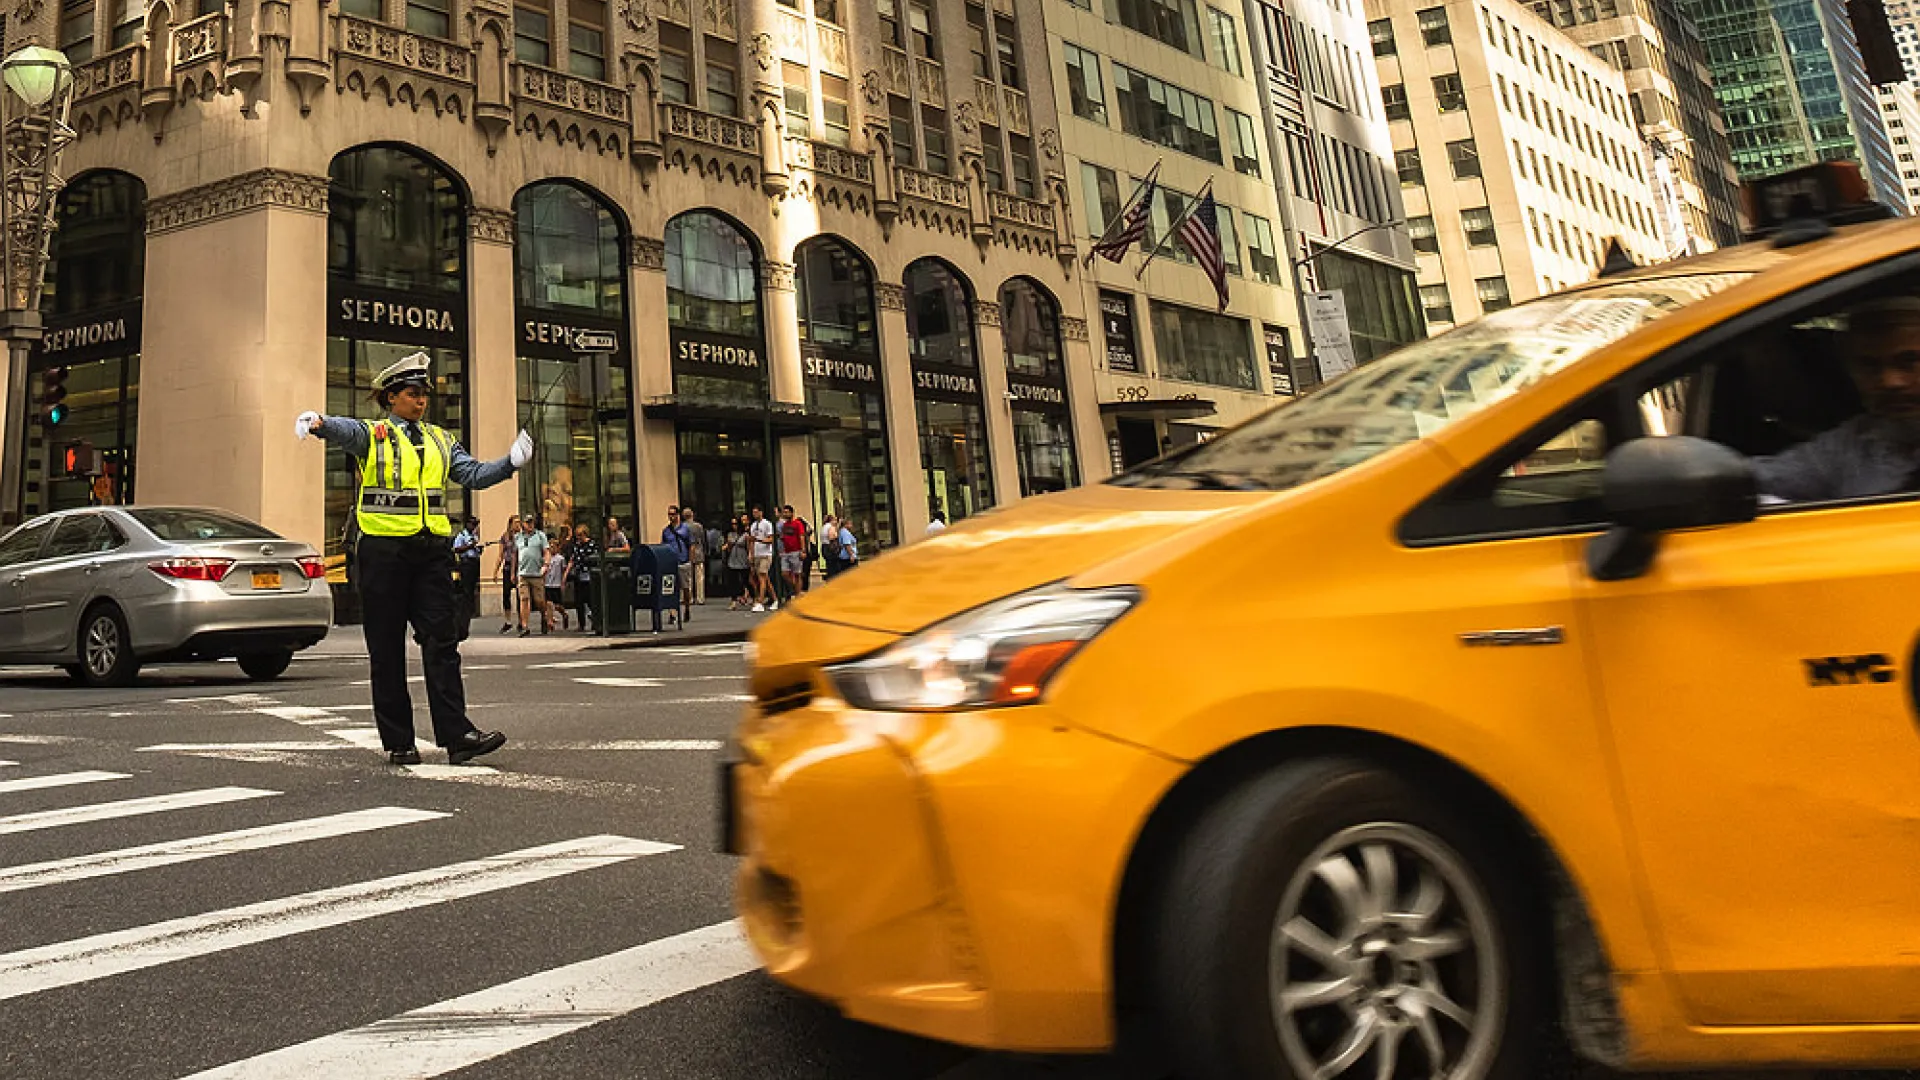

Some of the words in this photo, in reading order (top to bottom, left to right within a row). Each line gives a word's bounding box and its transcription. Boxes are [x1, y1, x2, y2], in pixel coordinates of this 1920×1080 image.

[341, 298, 454, 331] SEPHORA
[43, 318, 126, 354] SEPHORA
[525, 320, 574, 346] SEPH
[679, 341, 759, 367] SEPHORA
[806, 357, 876, 382] SEPHORA
[916, 370, 977, 393] SEPHORA
[1117, 386, 1149, 402] 590
[375, 493, 400, 507] NY
